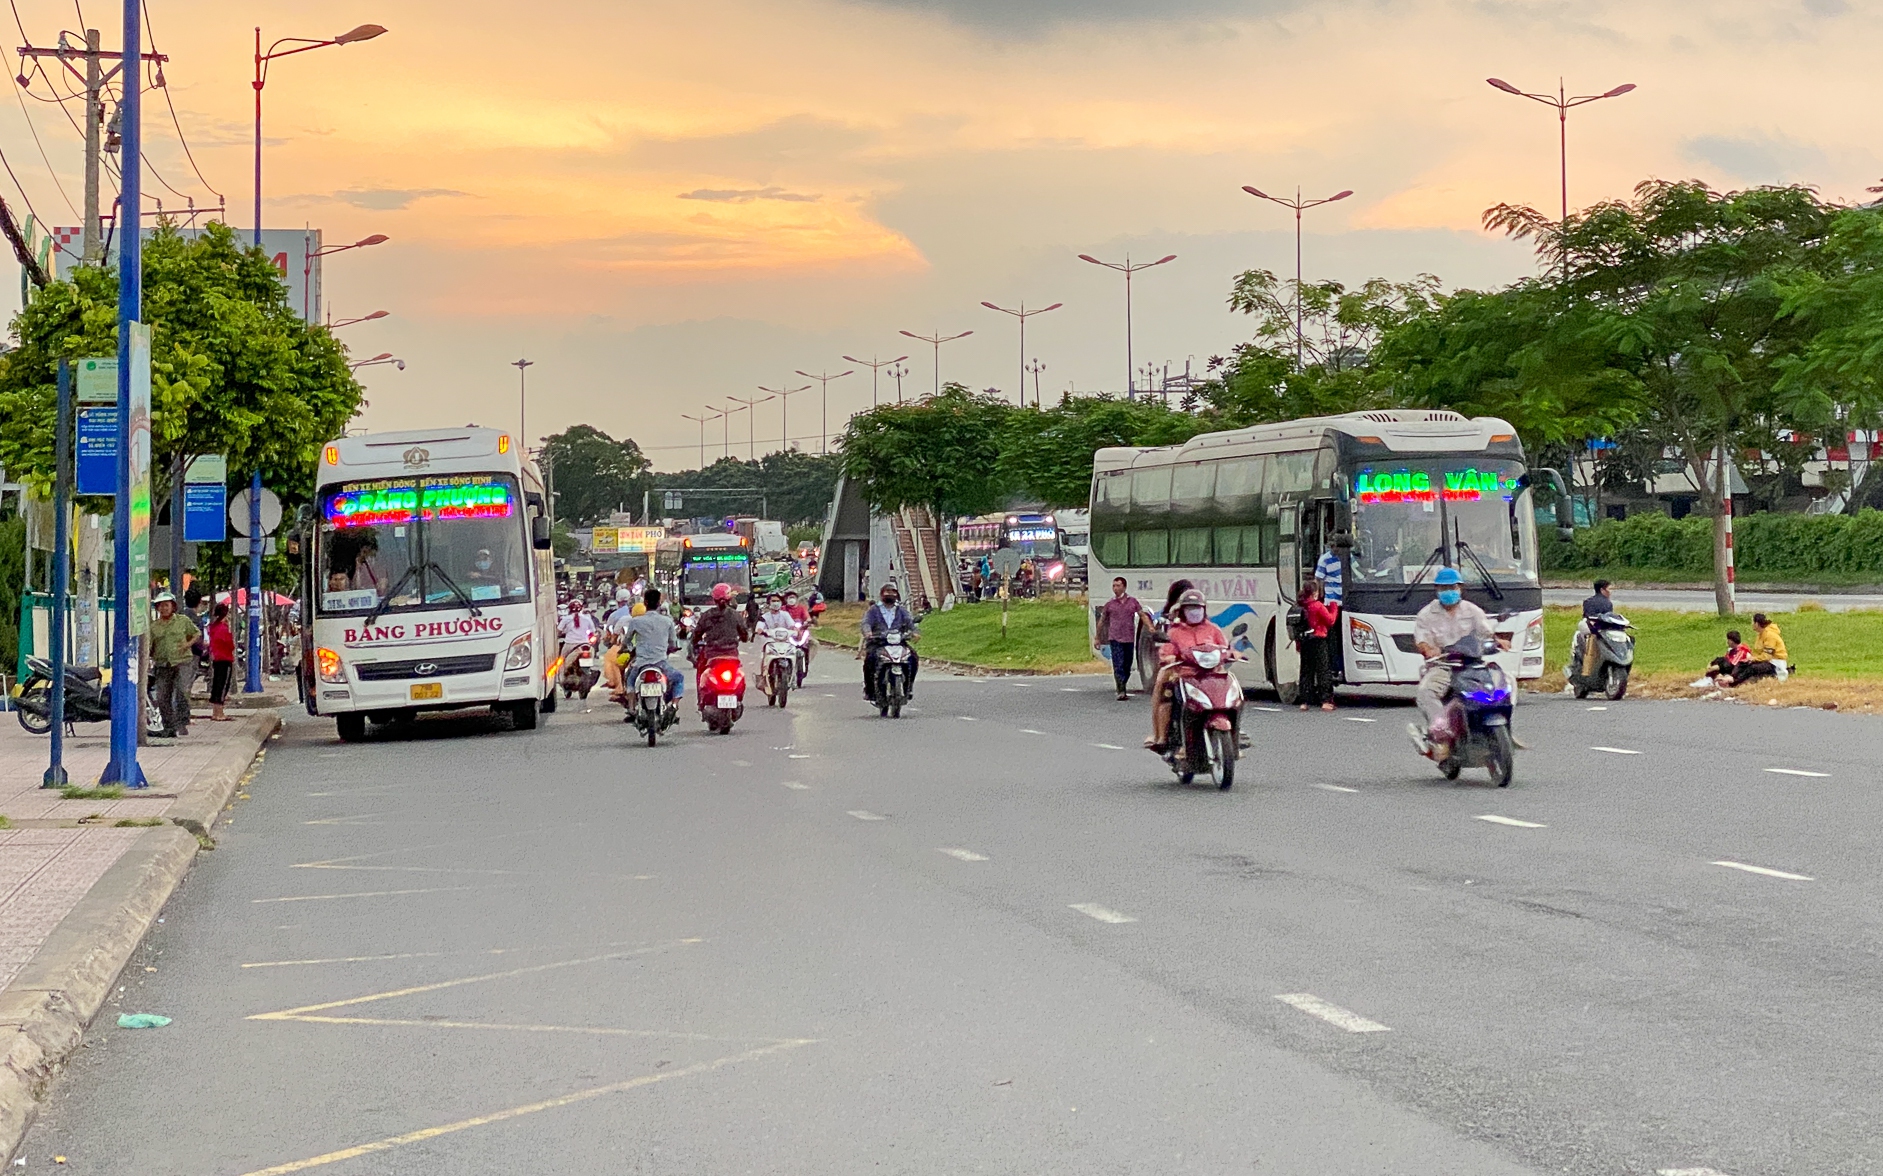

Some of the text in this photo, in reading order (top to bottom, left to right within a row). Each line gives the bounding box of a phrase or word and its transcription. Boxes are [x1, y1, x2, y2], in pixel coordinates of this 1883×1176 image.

[360, 482, 371, 491] XE
[1359, 468, 1499, 493] LONG VÂN
[1221, 574, 1258, 599] VÂN
[415, 617, 503, 636] PHƯỢNG
